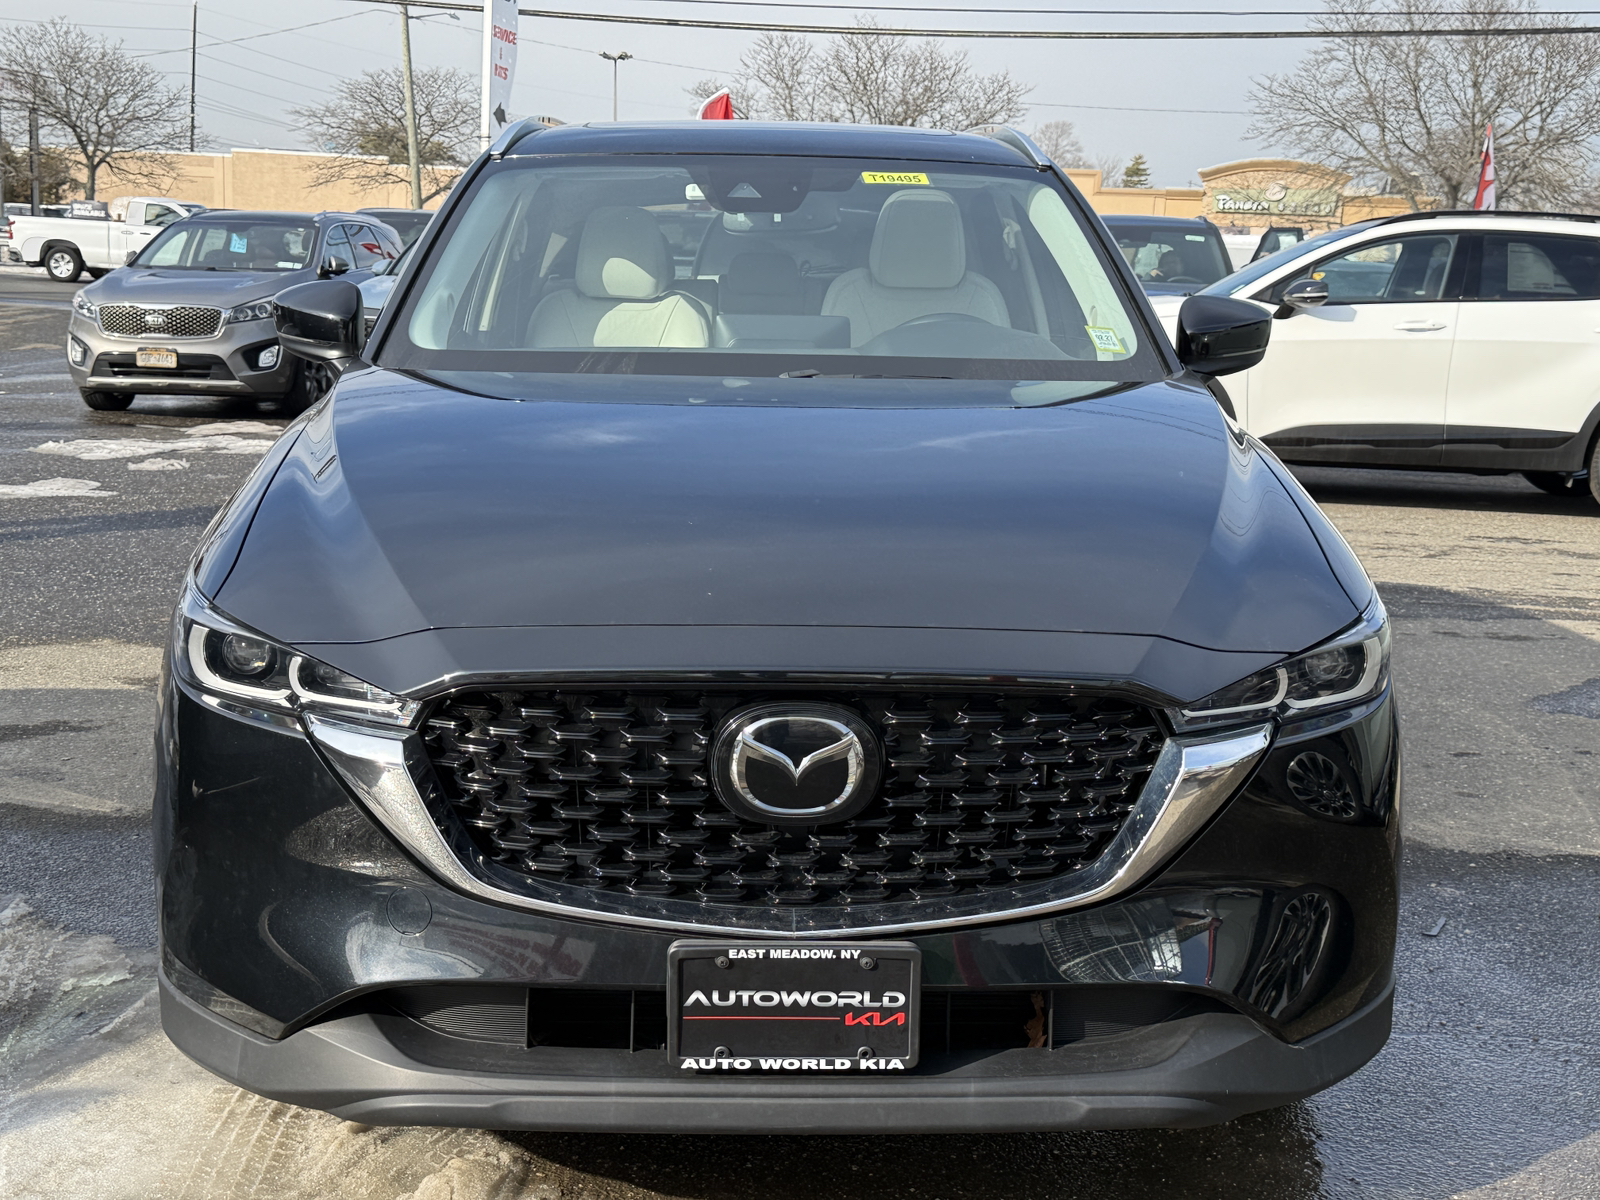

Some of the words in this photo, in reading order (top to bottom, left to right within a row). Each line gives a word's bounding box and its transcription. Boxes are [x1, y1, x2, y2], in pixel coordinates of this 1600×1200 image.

[868, 174, 921, 183] T19495
[728, 949, 766, 959] EAST
[840, 949, 861, 959] NY
[683, 989, 906, 1008] AUTOWORLD
[681, 1058, 752, 1070] AUTO
[758, 1058, 852, 1070] WORLD
[859, 1058, 905, 1070] KIA
